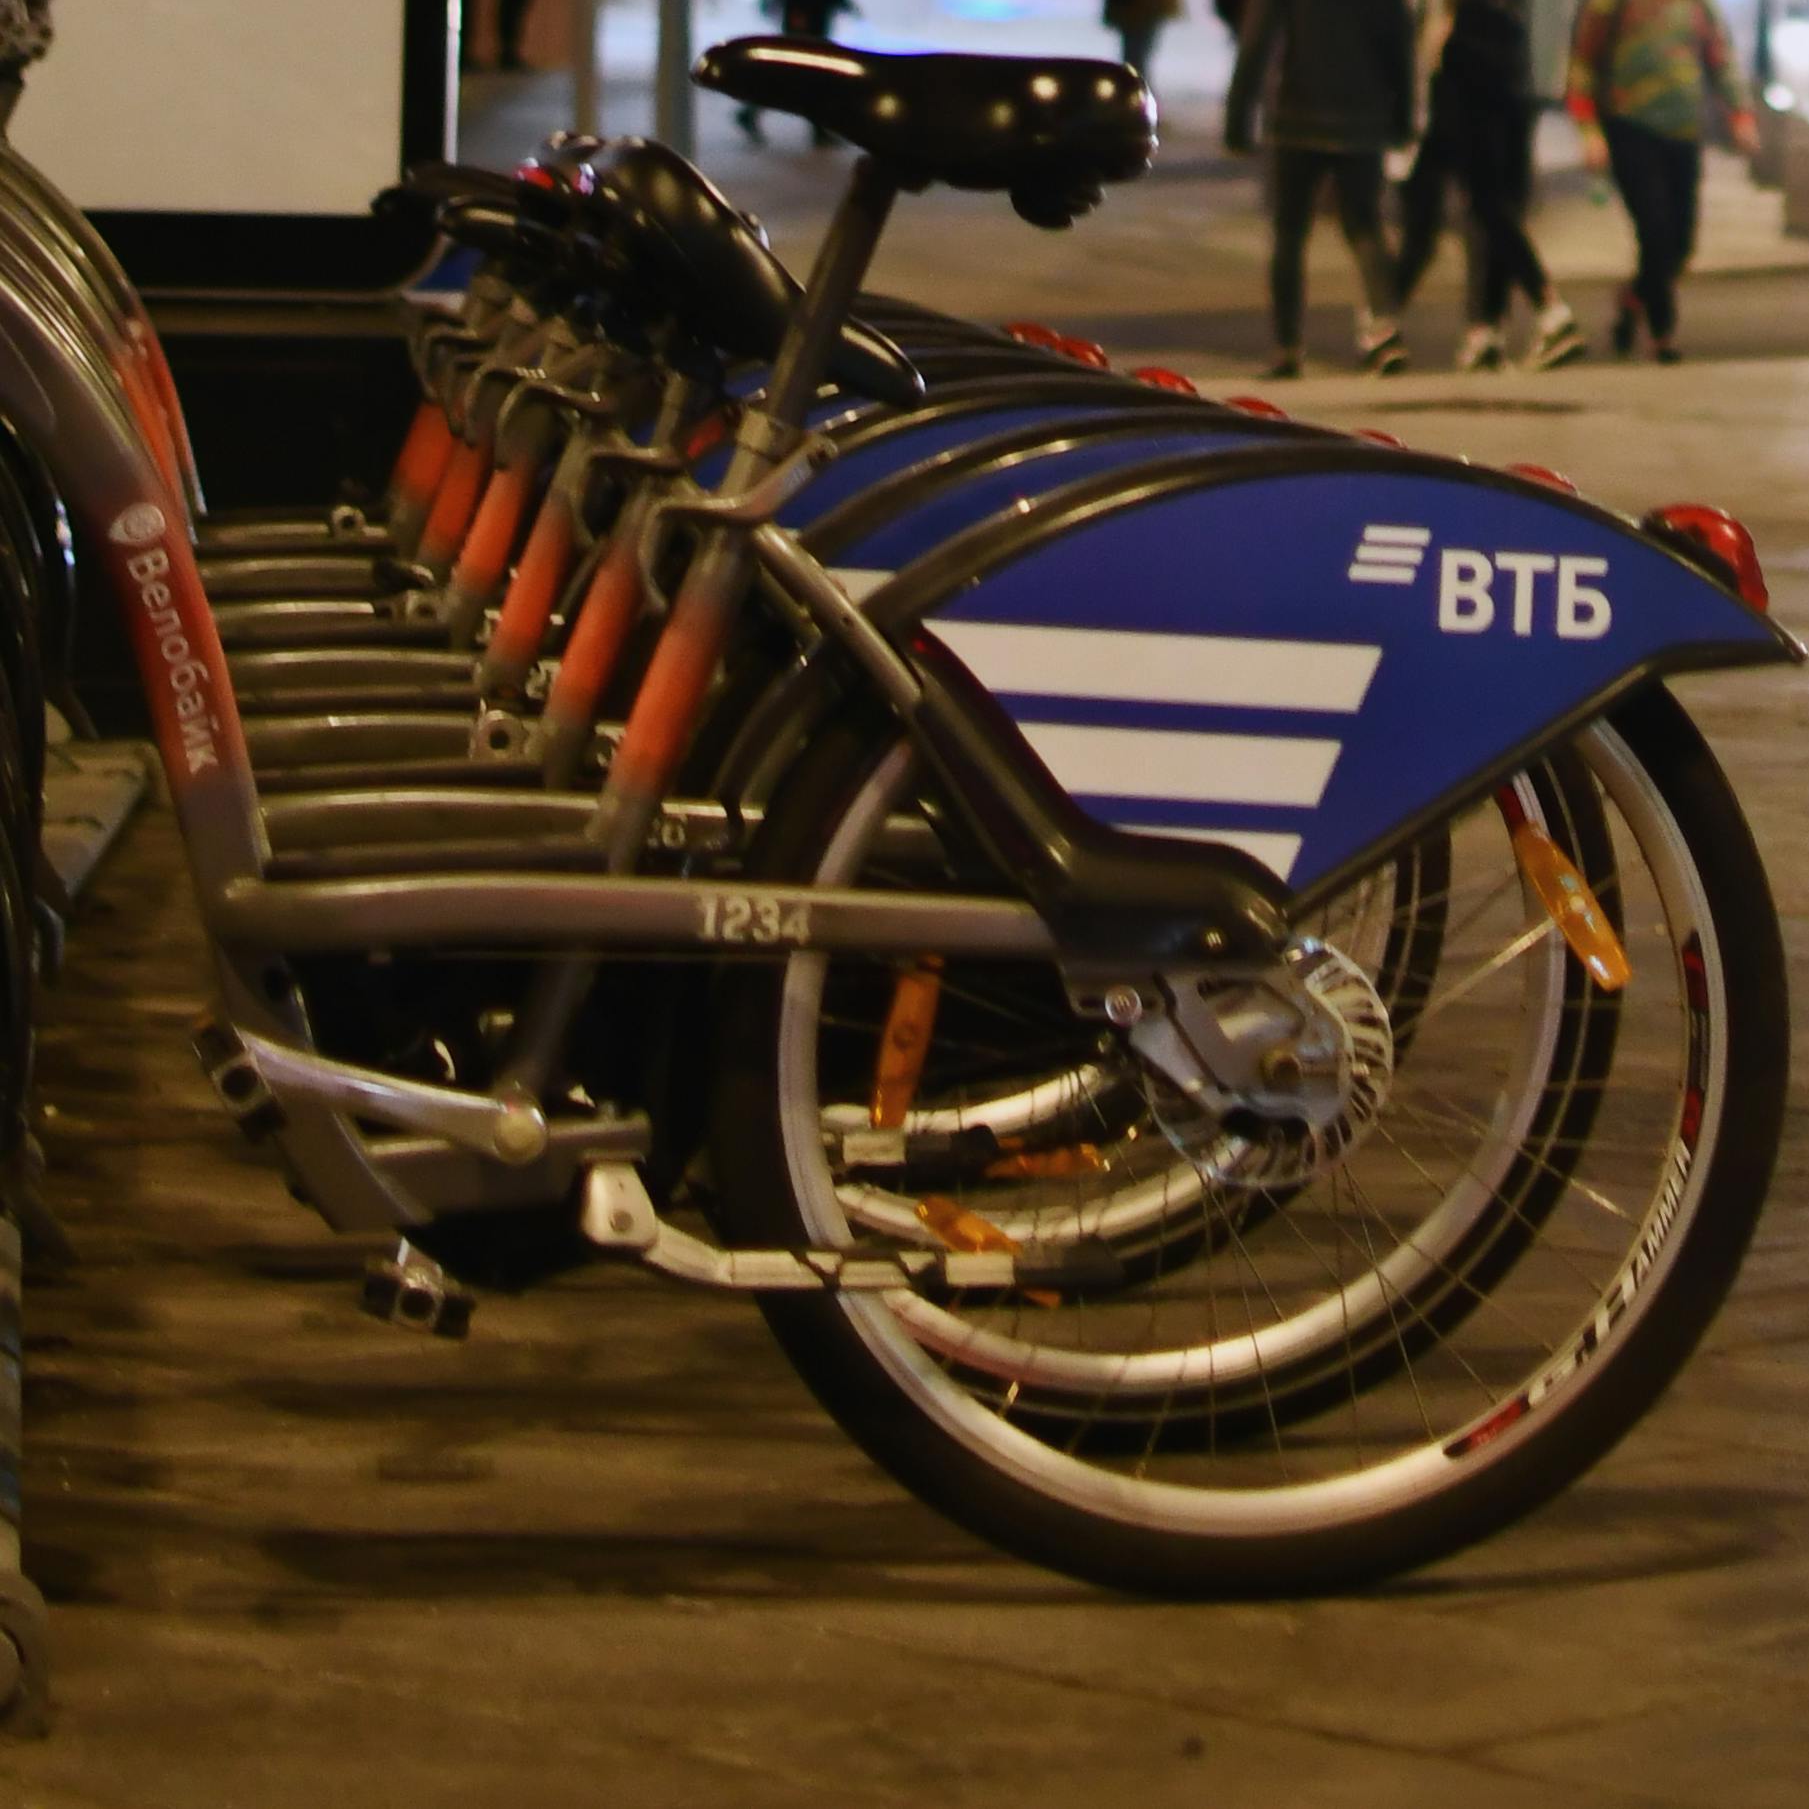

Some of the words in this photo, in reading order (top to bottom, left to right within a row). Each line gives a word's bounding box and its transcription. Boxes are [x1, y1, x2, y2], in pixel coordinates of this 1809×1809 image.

[1438, 548, 1612, 640] ВТБ
[126, 546, 220, 776] Велобайк
[699, 892, 812, 946] 1234
